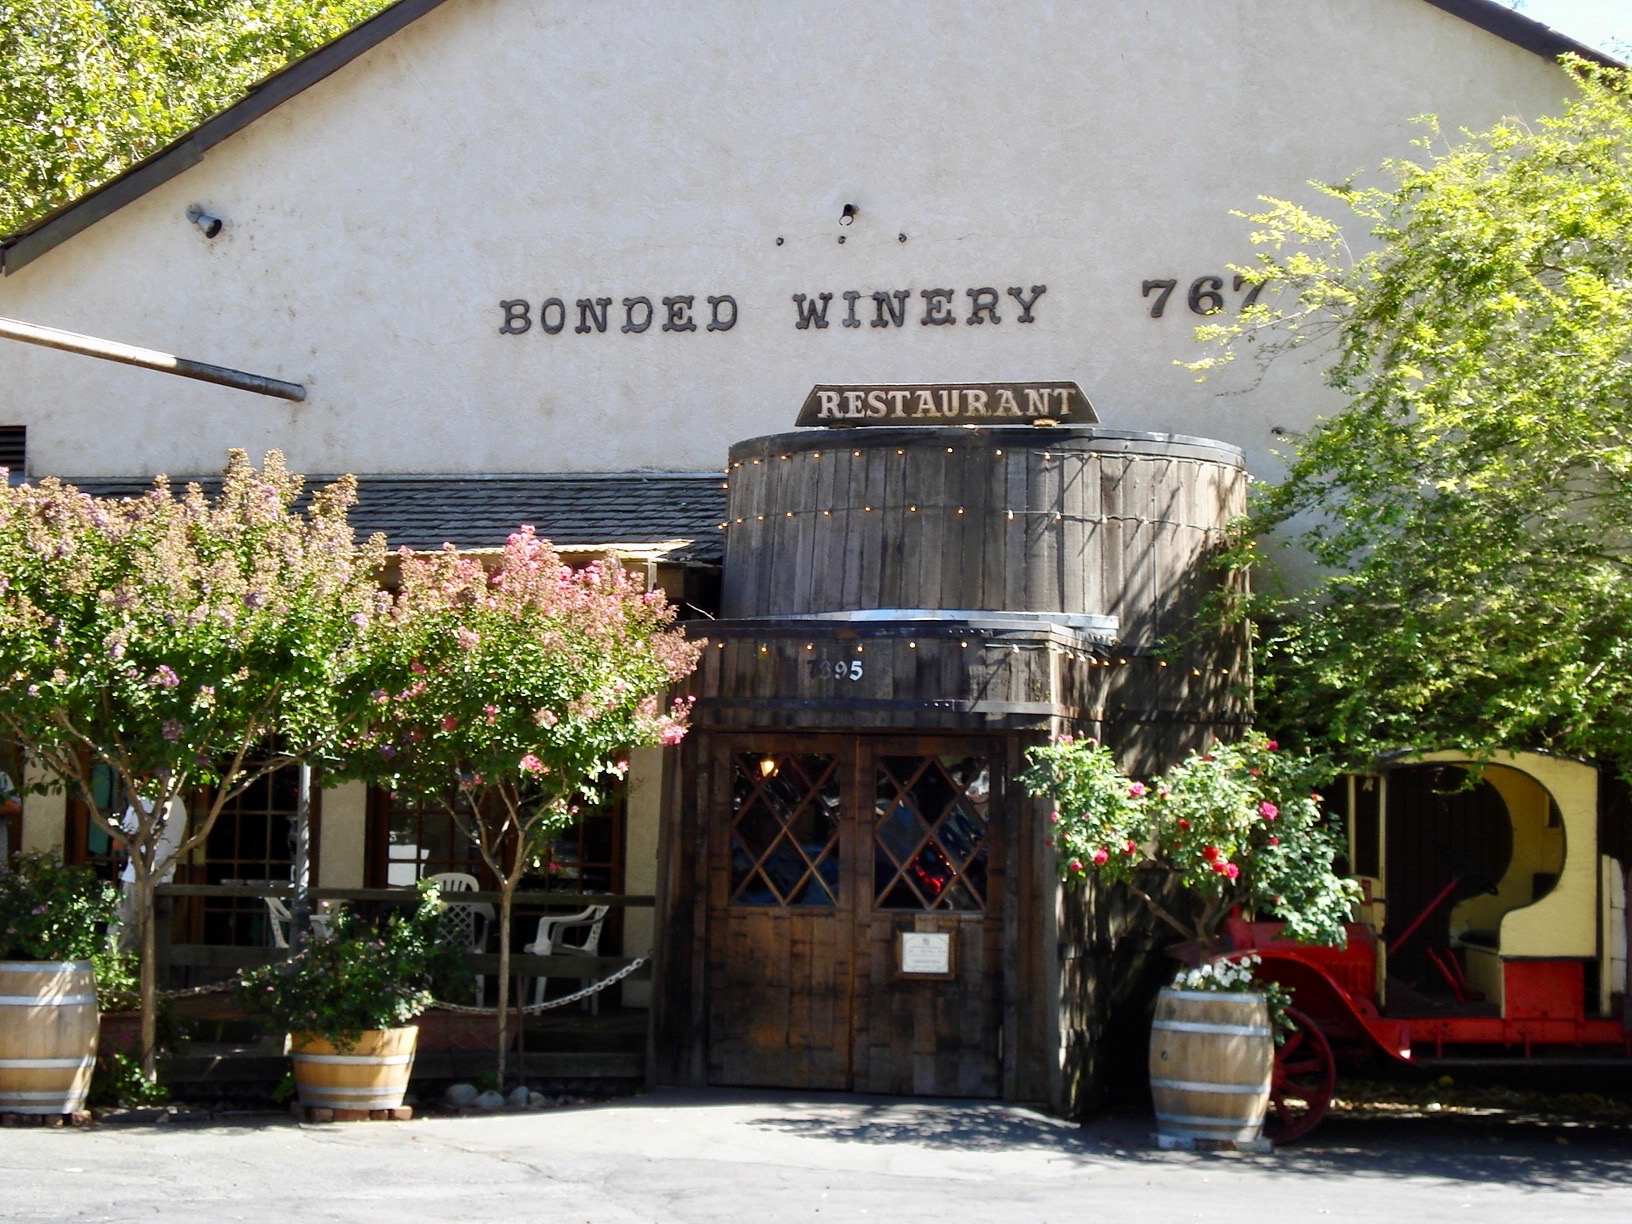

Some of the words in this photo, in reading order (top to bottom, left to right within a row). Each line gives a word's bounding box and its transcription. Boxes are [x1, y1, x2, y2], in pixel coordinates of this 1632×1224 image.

[499, 295, 738, 335] BONDED
[793, 285, 1047, 329] WINERY
[1142, 275, 1268, 319] 767
[816, 388, 1077, 420] RESTAURANT
